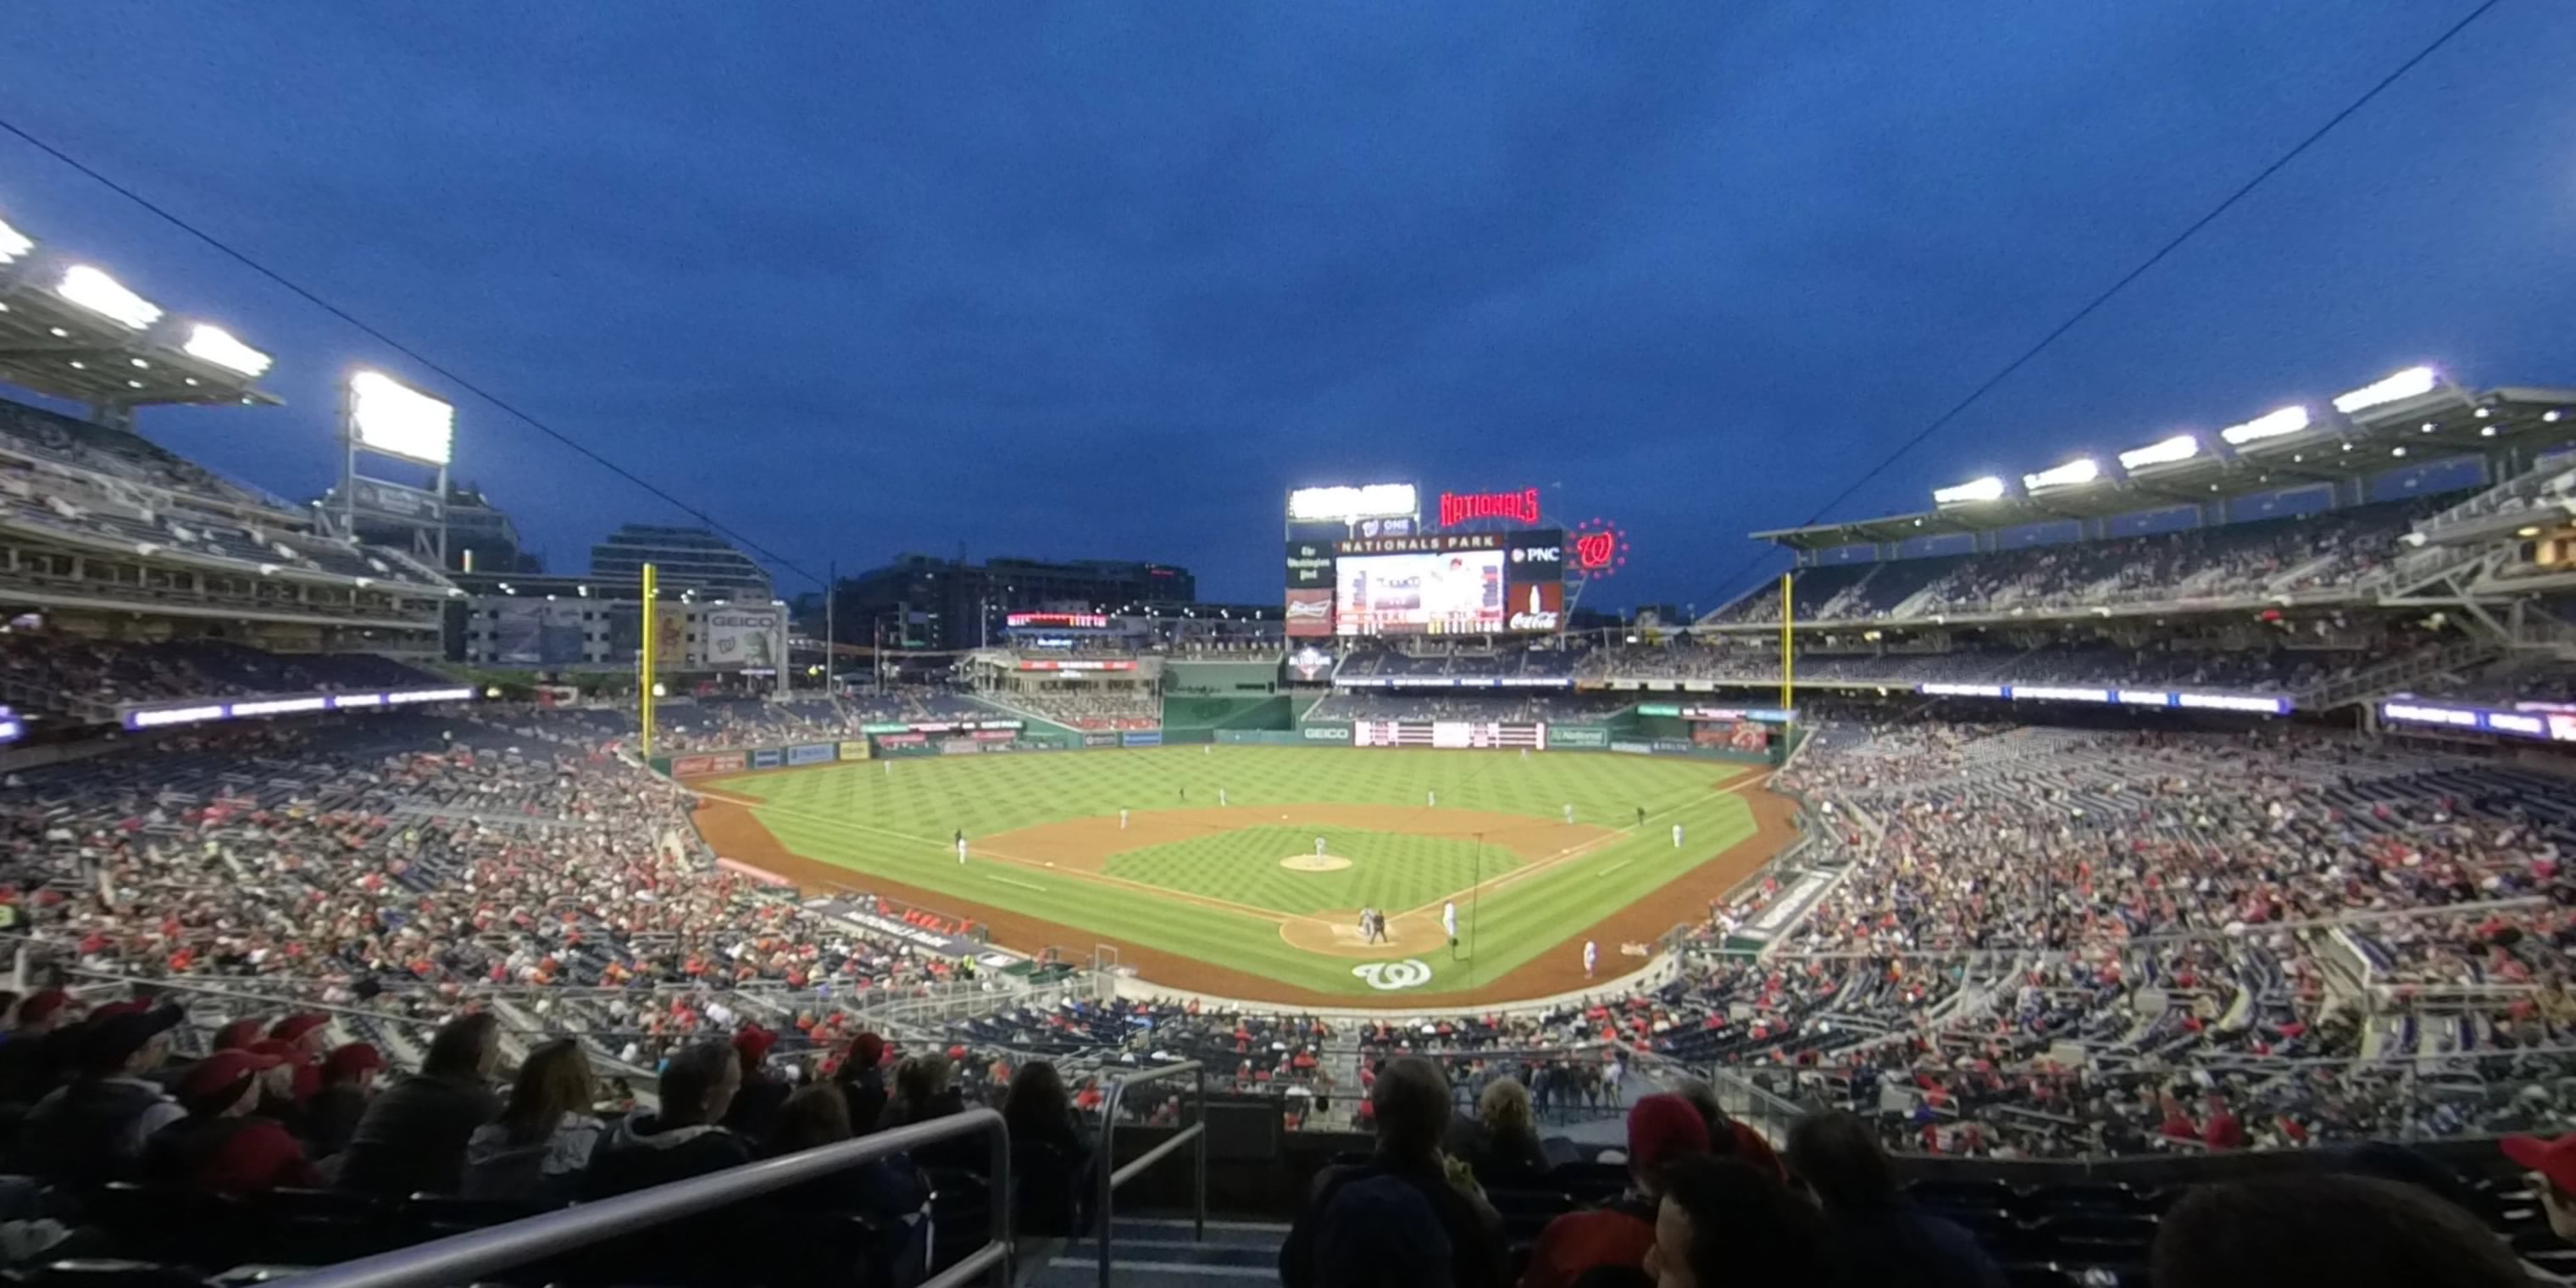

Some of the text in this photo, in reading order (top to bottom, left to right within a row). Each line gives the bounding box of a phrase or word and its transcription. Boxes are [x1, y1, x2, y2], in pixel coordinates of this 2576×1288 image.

[1441, 488, 1539, 527] NATIONALS
[1341, 535, 1494, 552] NATIONALS PARK
[1577, 531, 1614, 567] W
[1527, 547, 1560, 562] PNC
[712, 616, 775, 628] GEICO
[1304, 727, 1349, 740] GEICO
